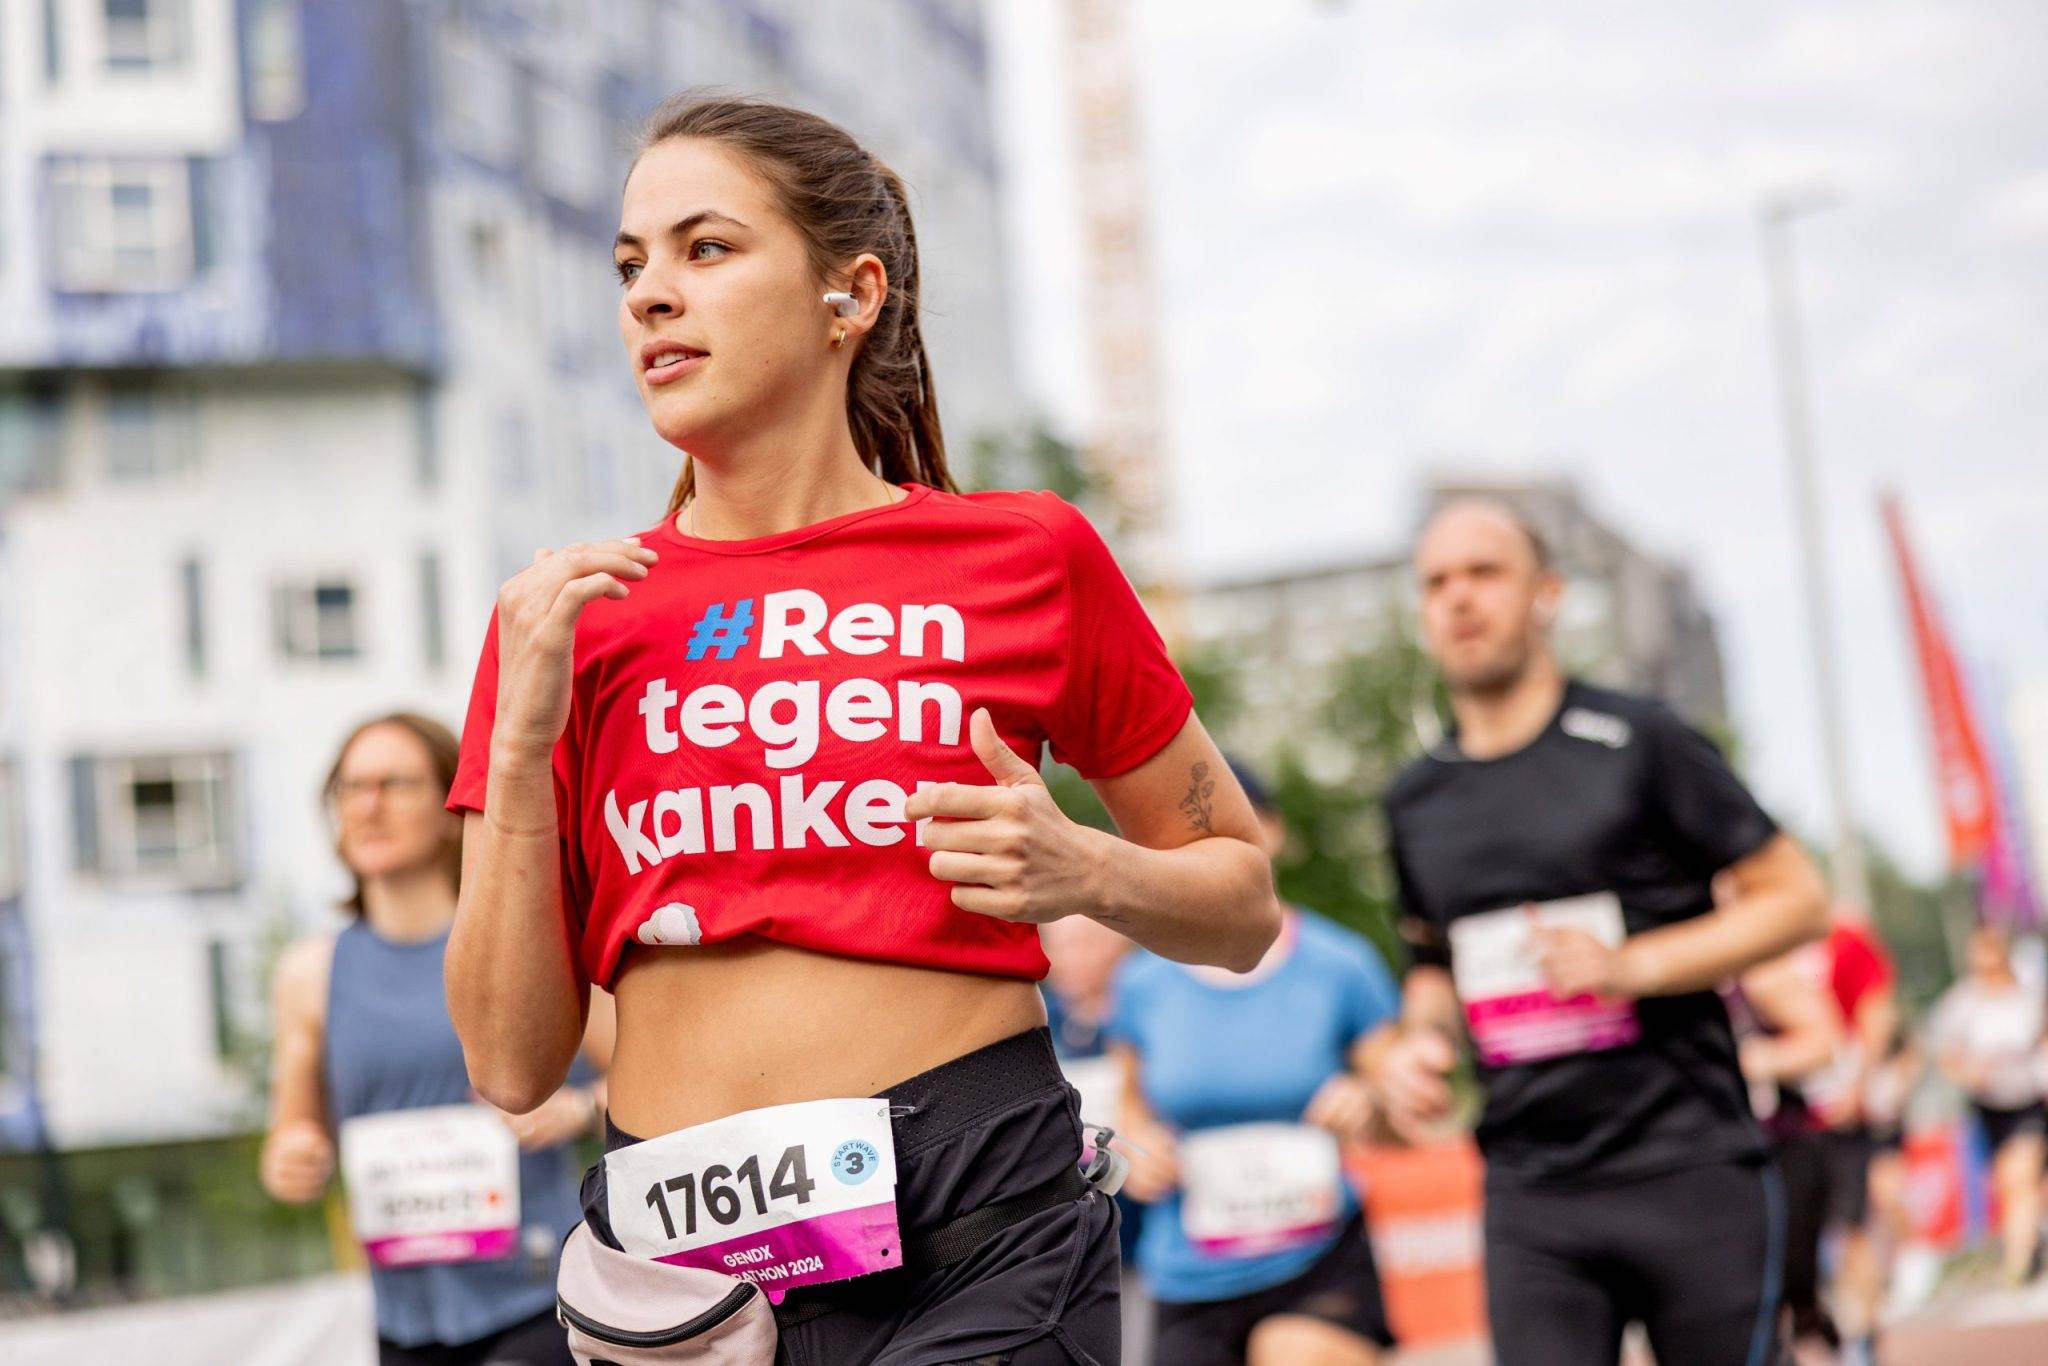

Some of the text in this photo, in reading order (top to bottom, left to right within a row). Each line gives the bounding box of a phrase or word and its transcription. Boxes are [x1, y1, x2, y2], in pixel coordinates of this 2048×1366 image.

[685, 588, 965, 662] #Ren
[638, 677, 963, 769] tegen
[833, 1141, 876, 1167] STARTWAVE
[845, 1152, 864, 1175] 3
[645, 1144, 816, 1240] 17614
[723, 1245, 774, 1268] GENDX
[788, 1256, 824, 1276] 2024
